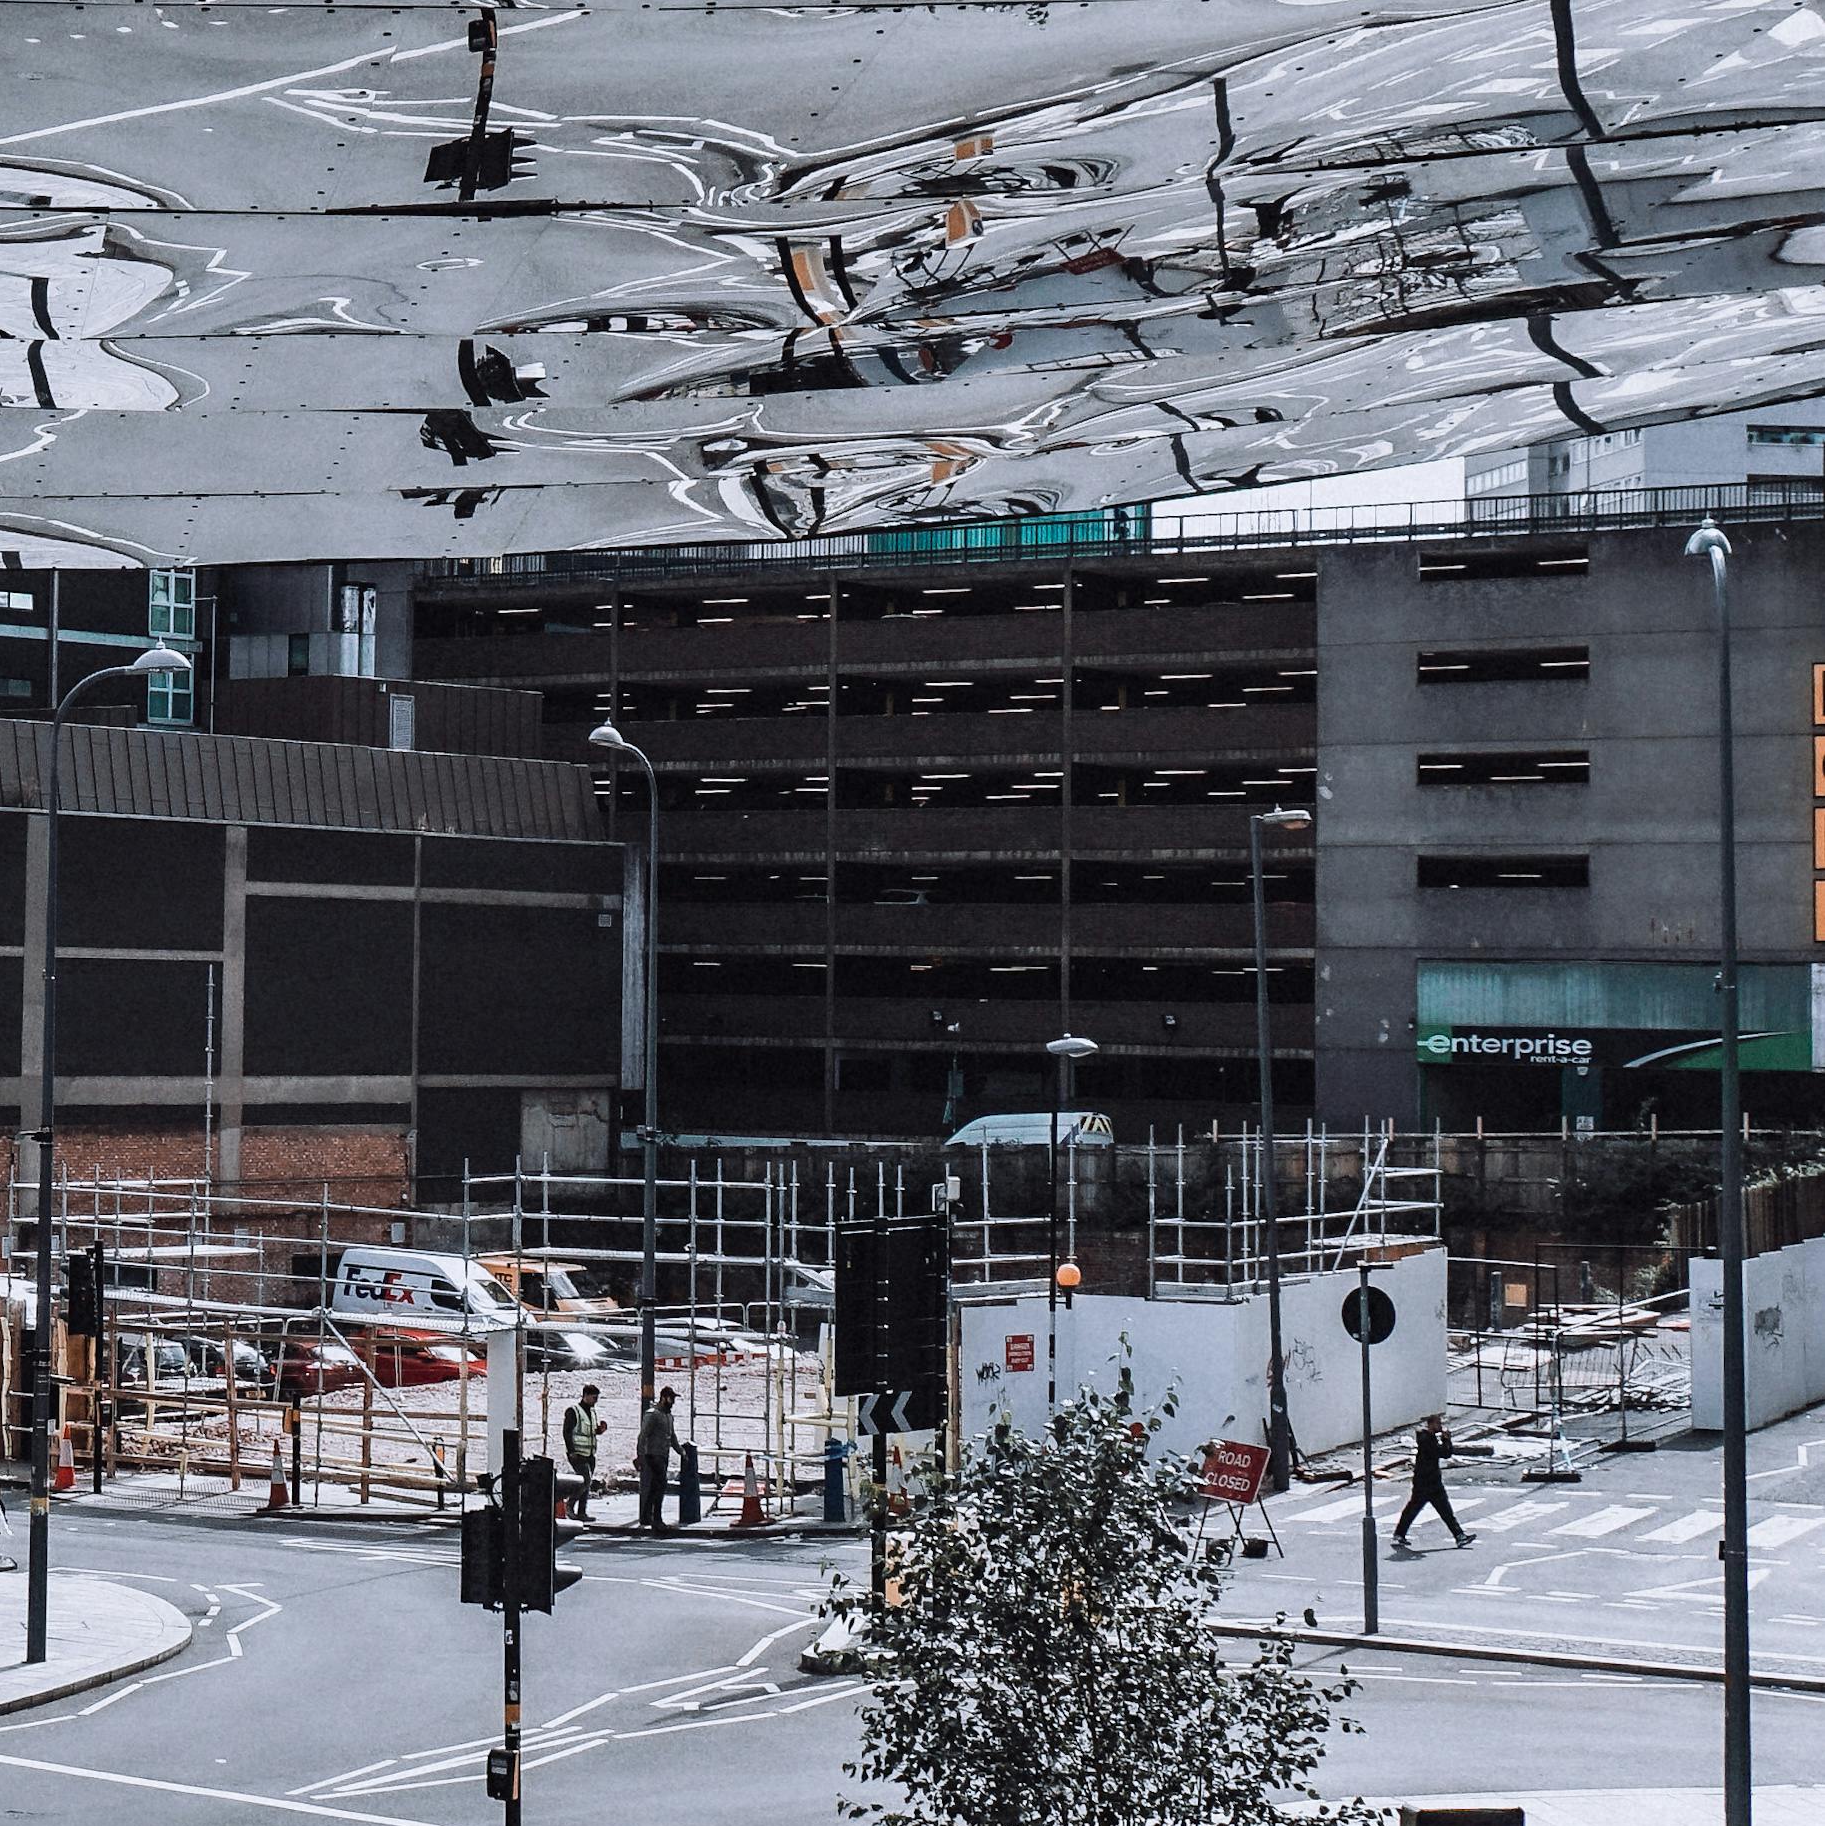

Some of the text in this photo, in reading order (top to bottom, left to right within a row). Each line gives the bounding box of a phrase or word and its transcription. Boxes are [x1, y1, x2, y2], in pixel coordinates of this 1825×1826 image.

[1417, 1034, 1592, 1059] enterprise
[1530, 1055, 1592, 1064] rent-a-car
[343, 1268, 415, 1305] FedEx
[1218, 1450, 1252, 1468] ROAD
[1206, 1472, 1251, 1492] CLOSED
